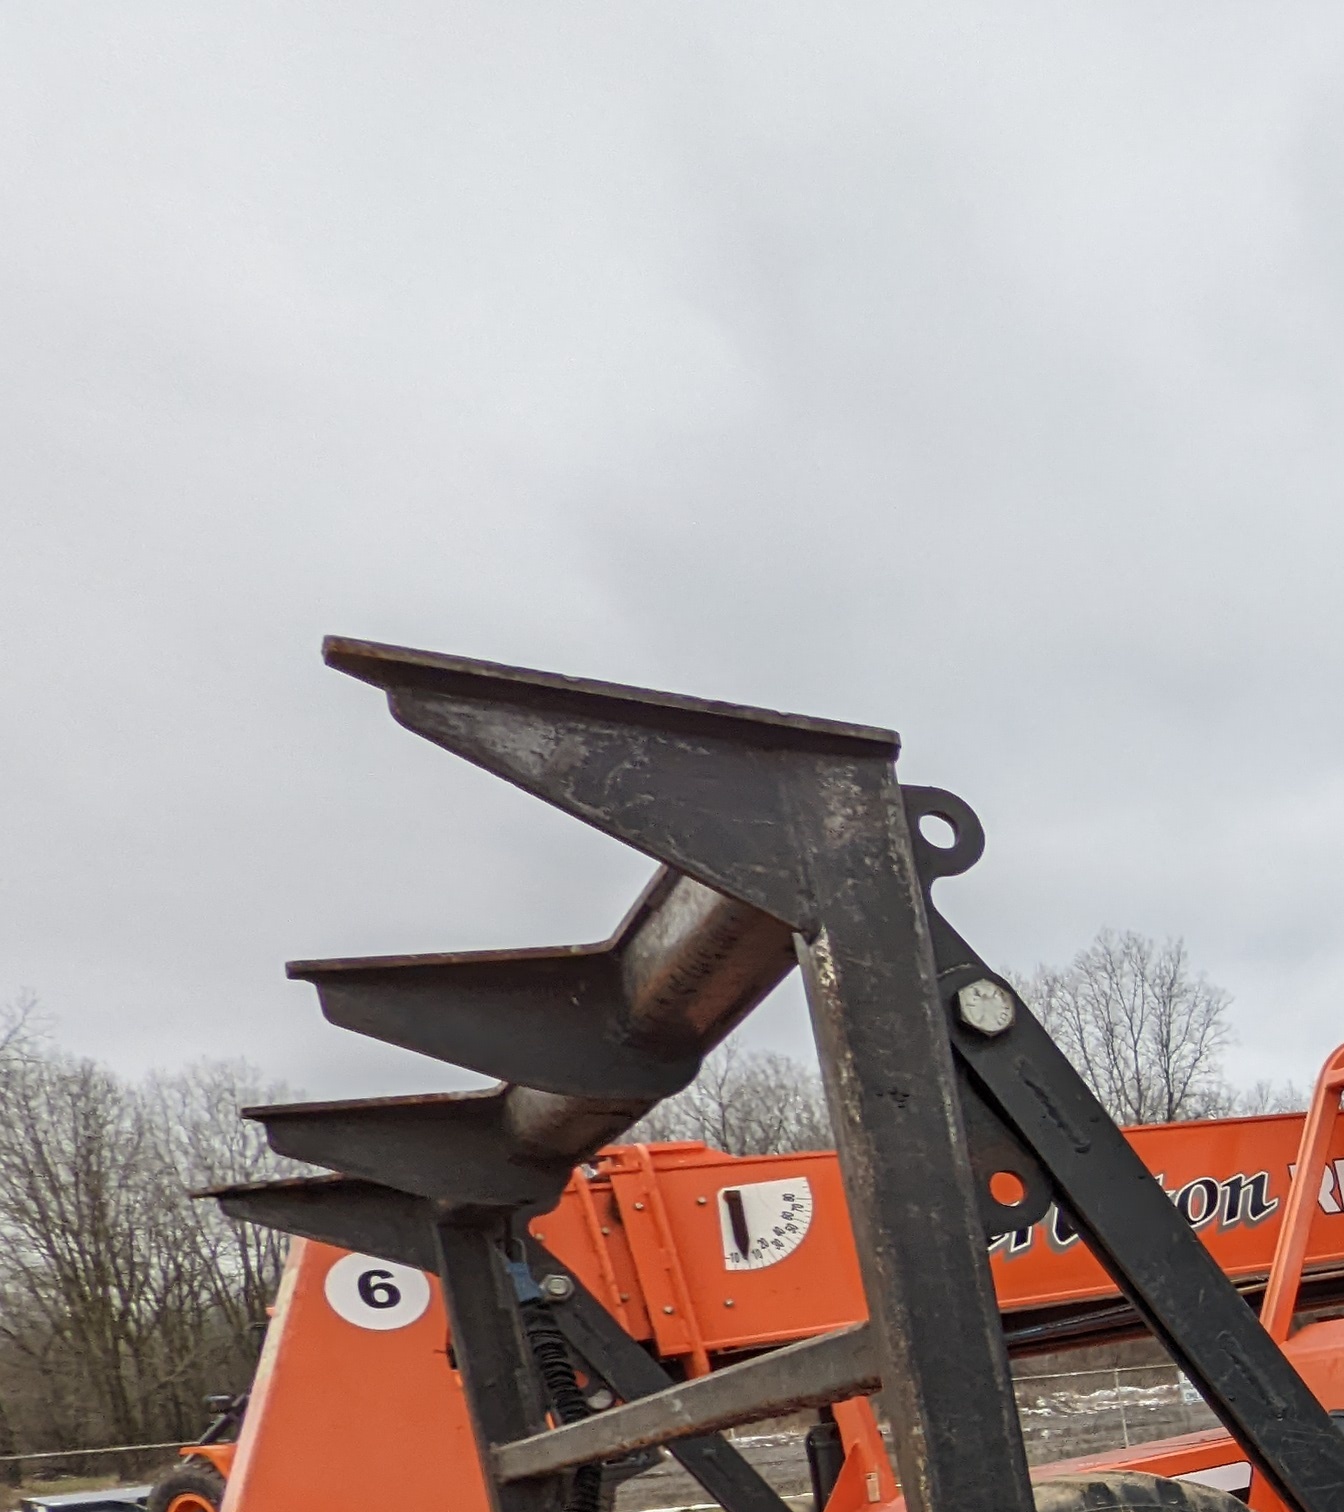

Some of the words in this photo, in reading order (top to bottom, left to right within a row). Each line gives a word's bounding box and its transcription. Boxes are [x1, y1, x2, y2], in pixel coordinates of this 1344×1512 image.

[781, 1192, 795, 1203] 80
[757, 1237, 769, 1250] 20
[357, 1269, 402, 1309] 6
